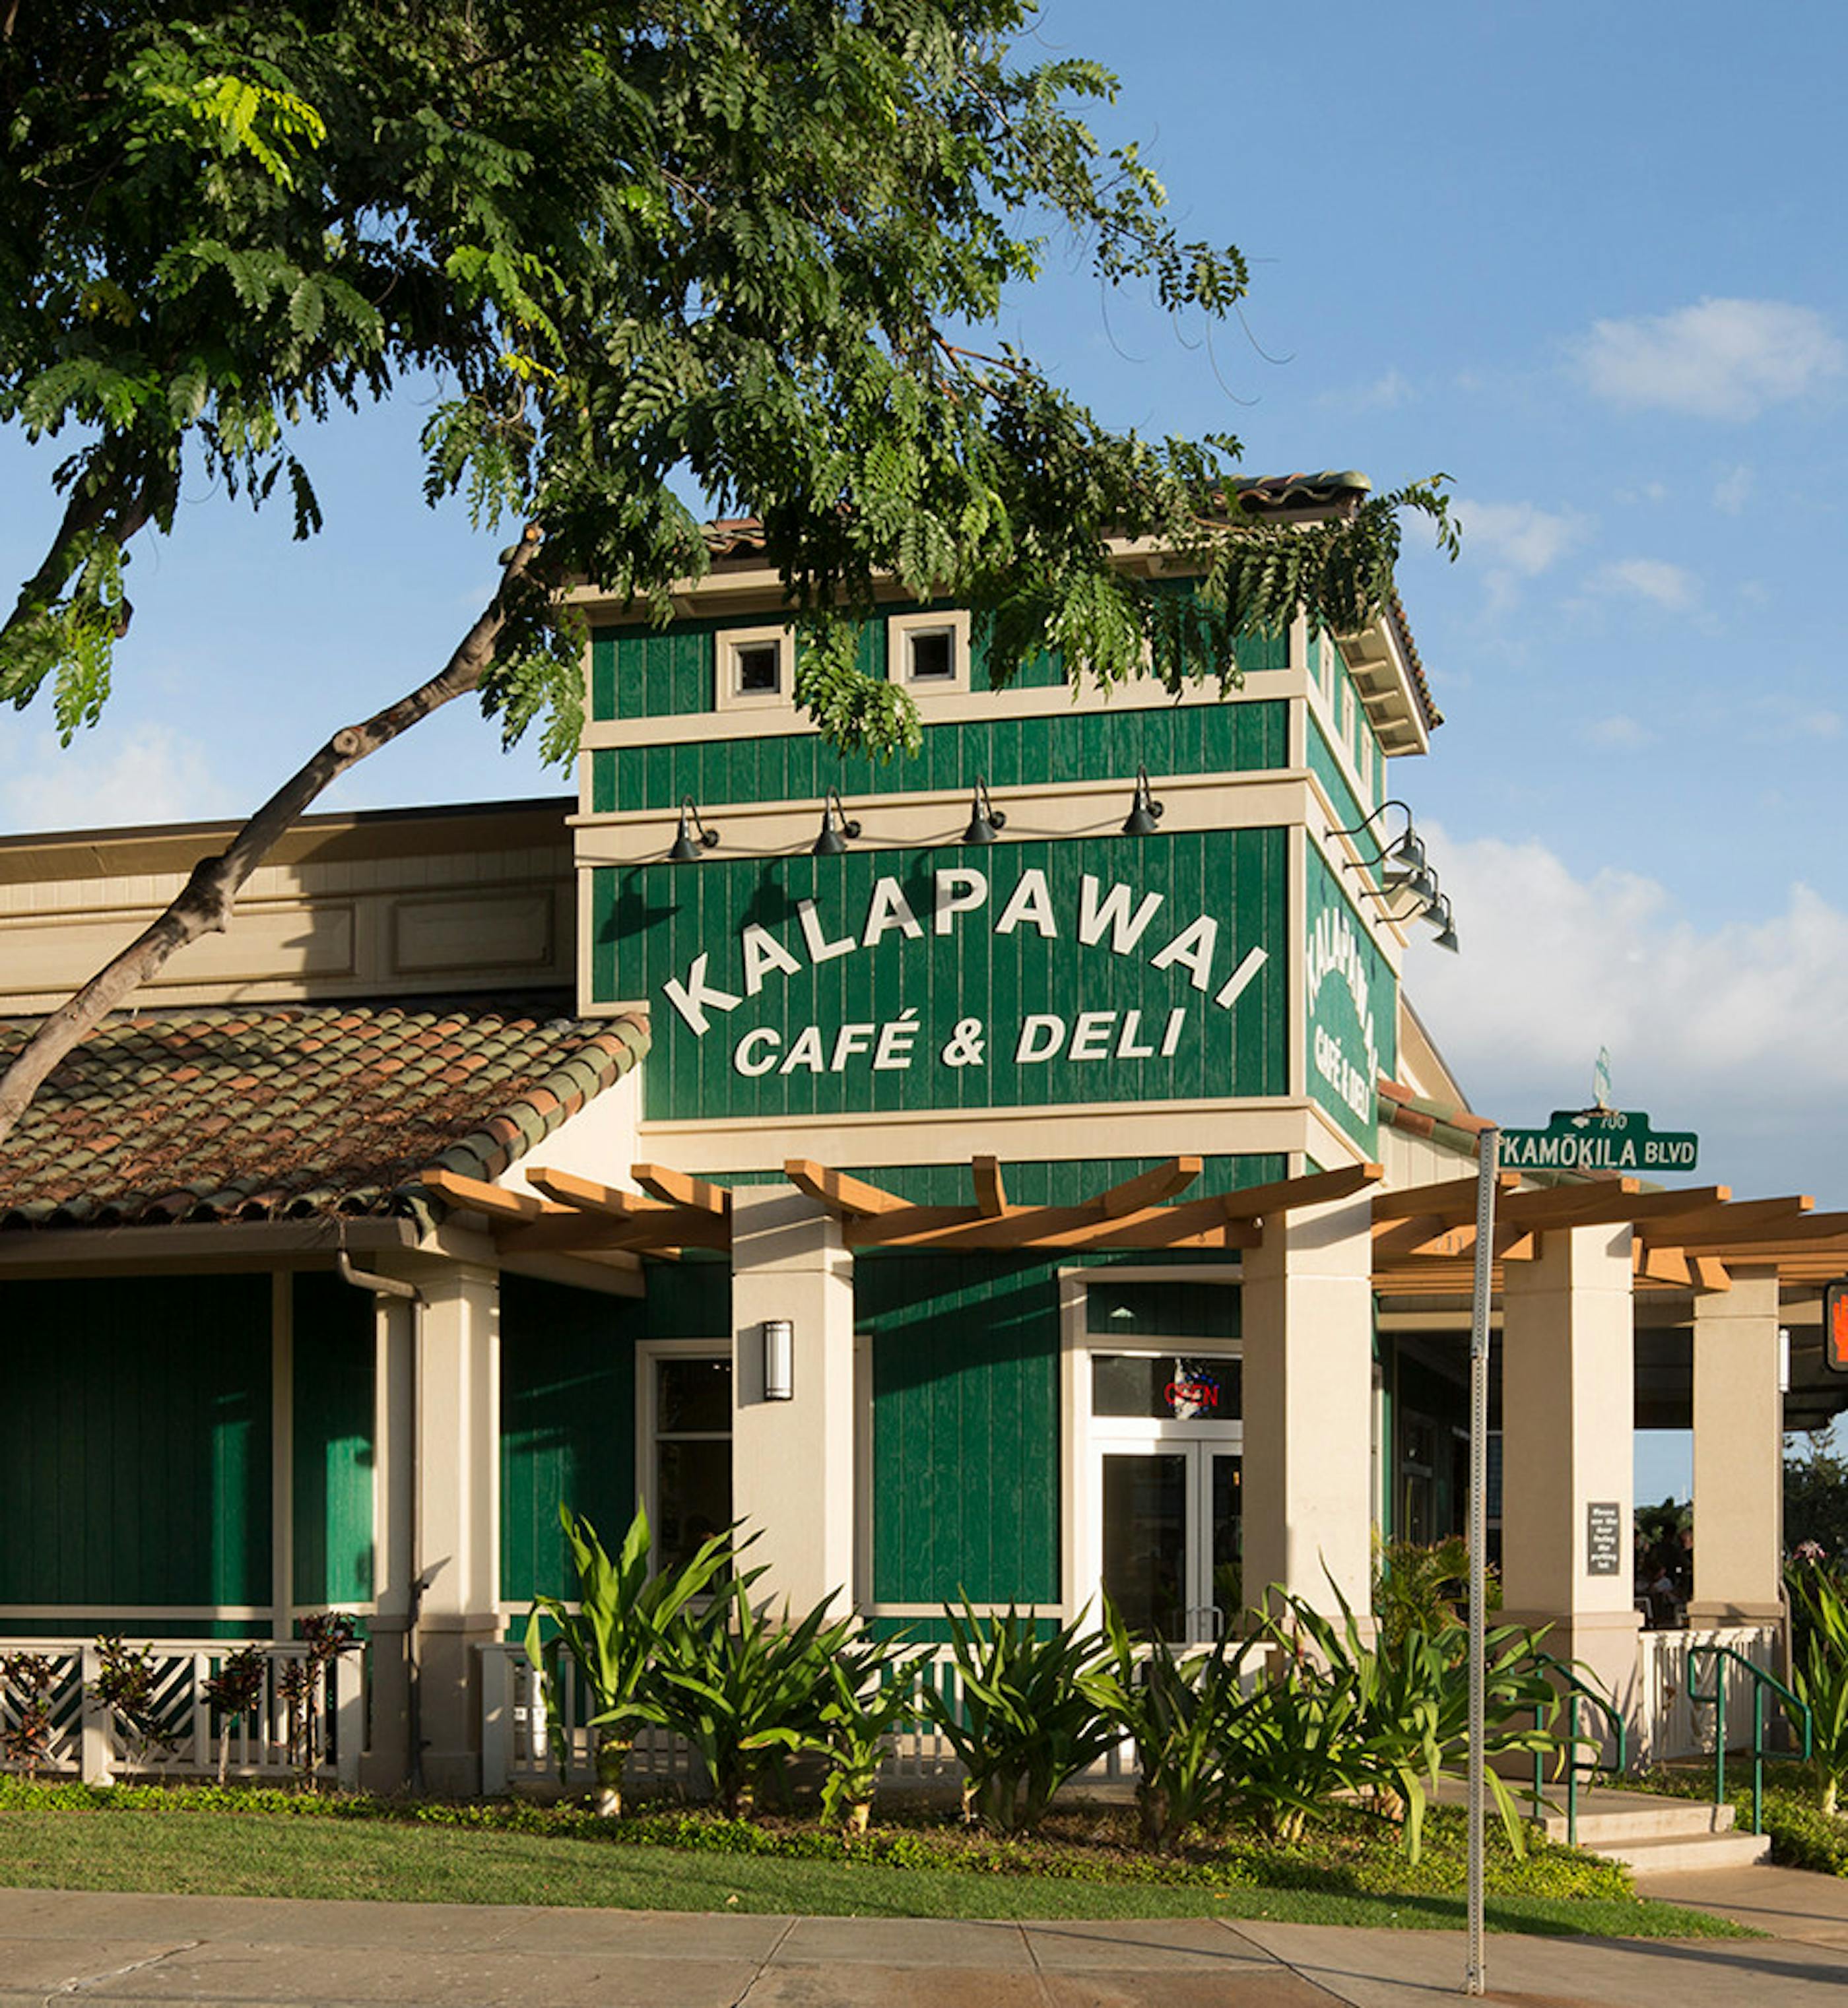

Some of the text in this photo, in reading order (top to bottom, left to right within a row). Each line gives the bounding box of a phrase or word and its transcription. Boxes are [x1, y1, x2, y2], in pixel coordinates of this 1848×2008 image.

[663, 868, 1269, 1037] KALAPAWAI
[734, 1007, 1187, 1077] CAFÉ & DELI
[1503, 1133, 1695, 1167] KAMŌKILA BLVD
